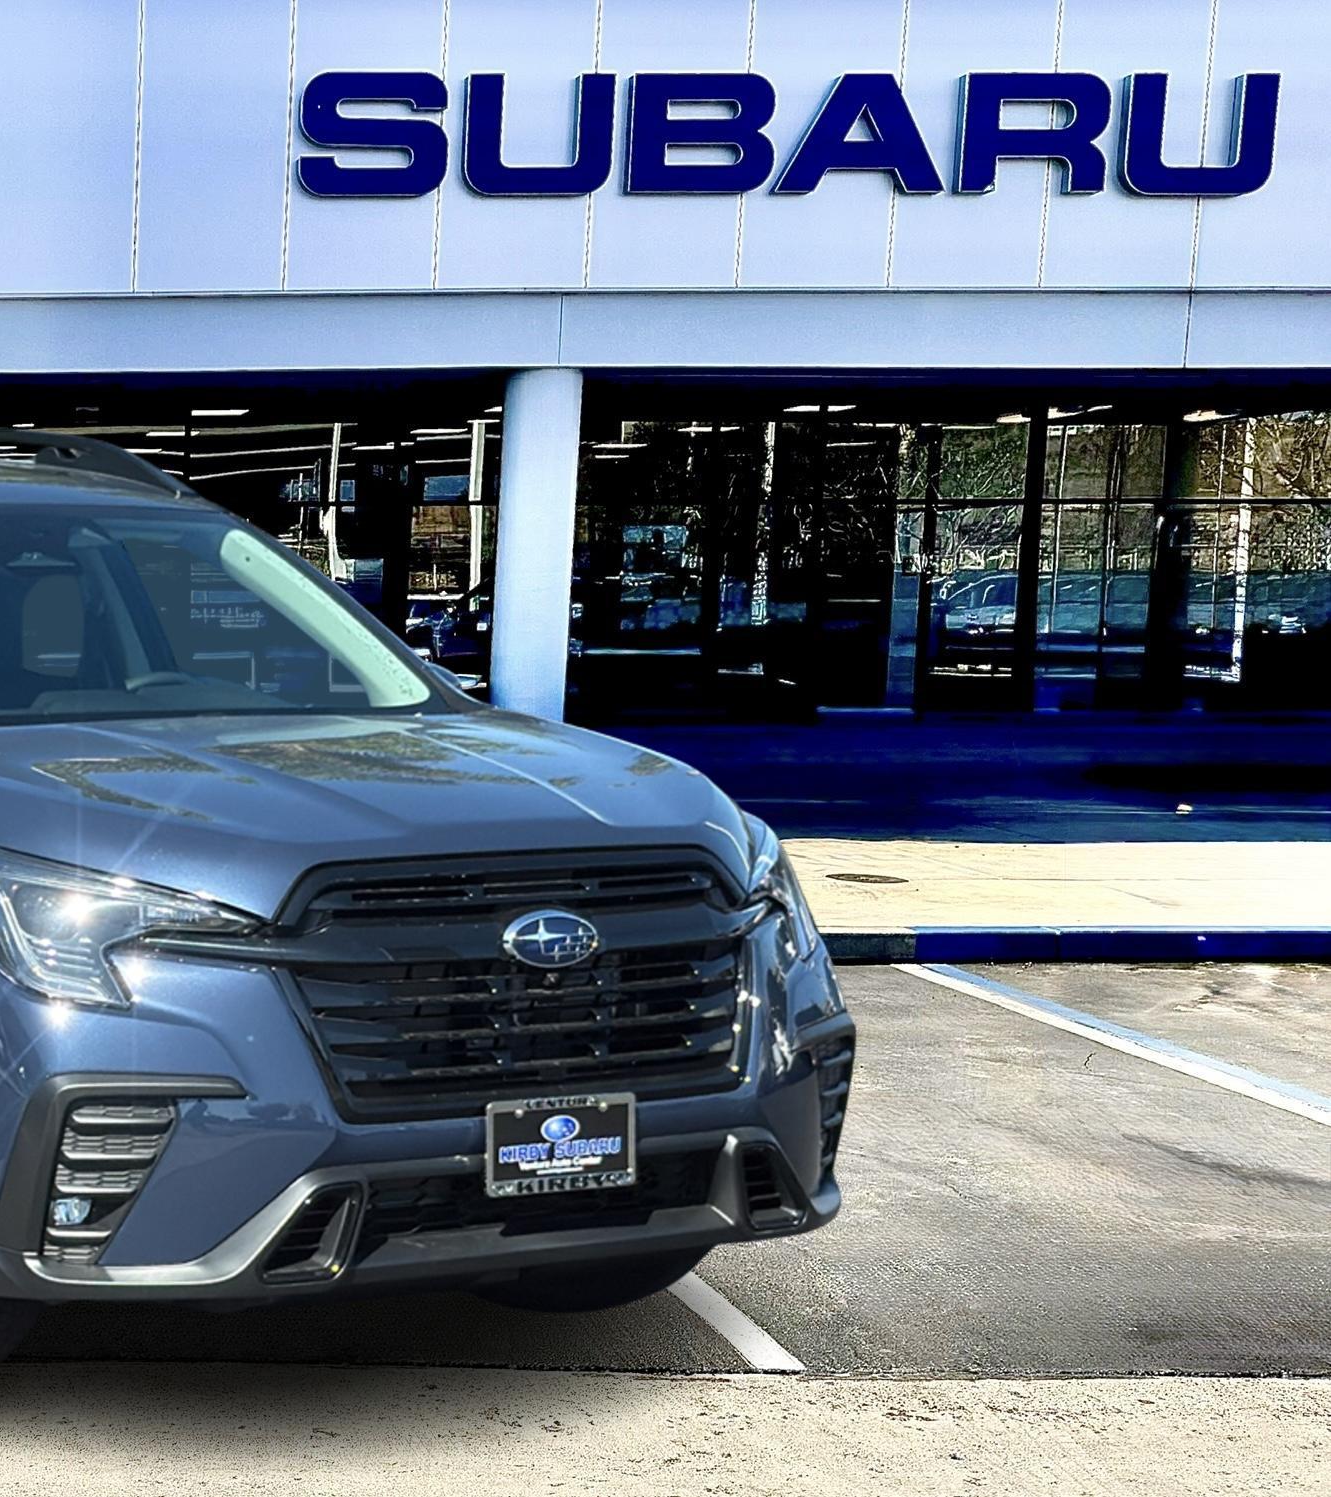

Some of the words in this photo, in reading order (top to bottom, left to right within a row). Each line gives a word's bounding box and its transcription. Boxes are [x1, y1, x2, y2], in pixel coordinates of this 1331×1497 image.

[297, 71, 1281, 198] SUBARU
[499, 1143, 550, 1163] KIRBY
[555, 1136, 621, 1157] SUBARU
[517, 1173, 605, 1193] KIRBY
